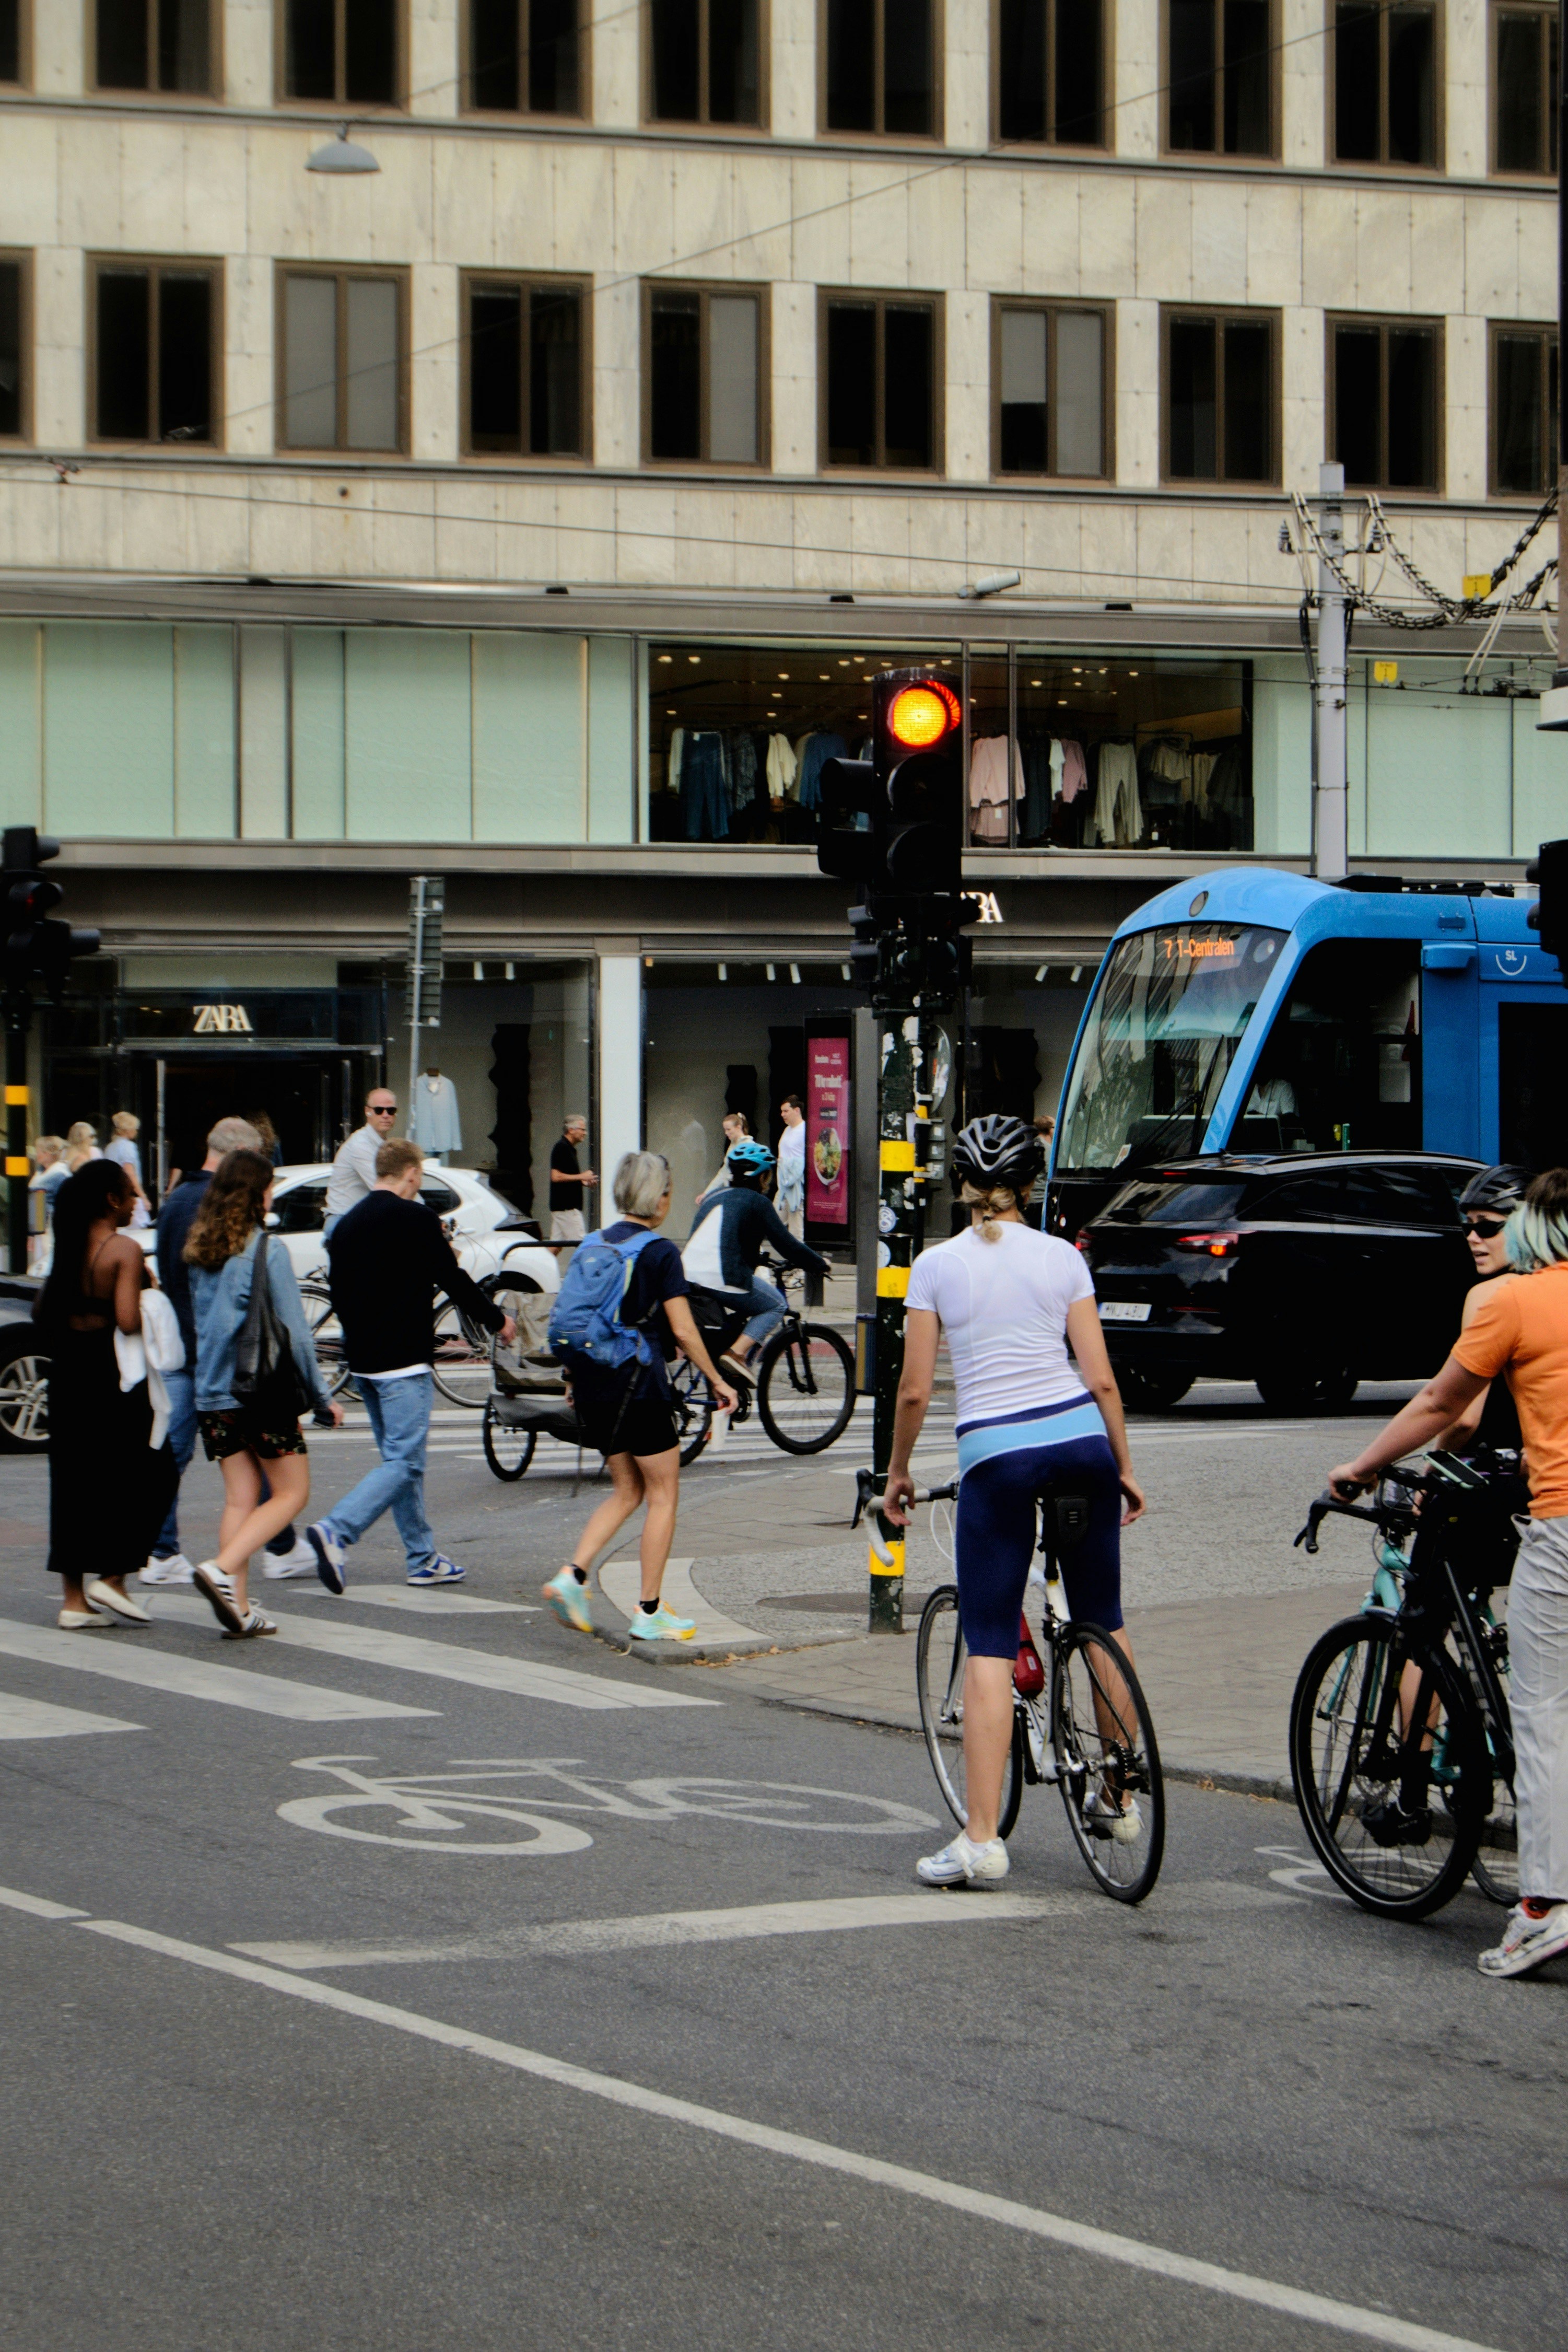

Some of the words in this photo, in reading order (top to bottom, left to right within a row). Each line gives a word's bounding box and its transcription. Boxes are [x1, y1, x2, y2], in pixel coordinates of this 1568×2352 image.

[1164, 940, 1172, 958] 7
[1177, 937, 1234, 958] T-Centralen
[1505, 950, 1517, 961] SL
[193, 1005, 253, 1032] ZARA
[1450, 1611, 1497, 1730] TREK
